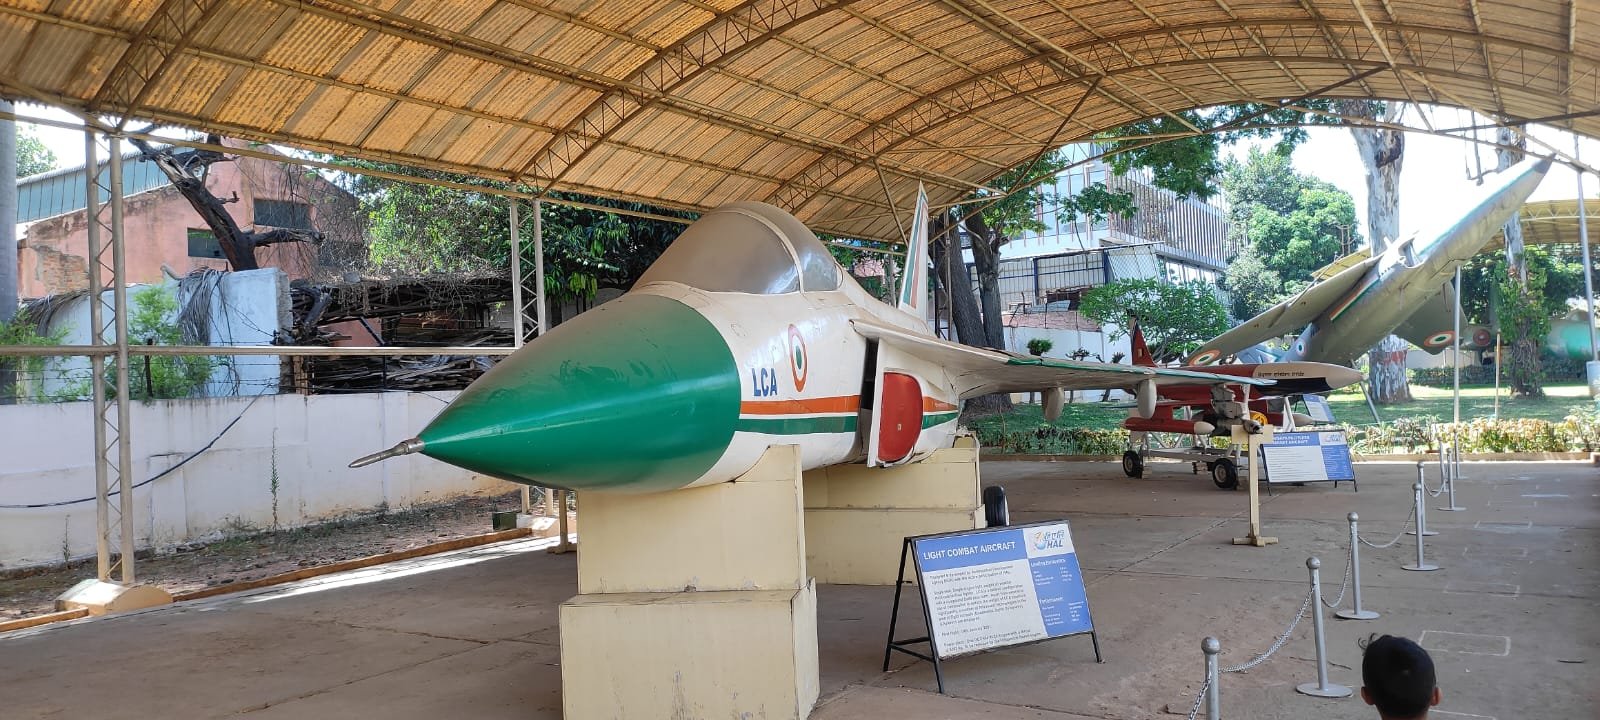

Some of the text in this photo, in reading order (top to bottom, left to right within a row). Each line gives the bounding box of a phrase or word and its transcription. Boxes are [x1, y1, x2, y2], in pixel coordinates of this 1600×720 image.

[751, 367, 778, 397] LCA
[923, 541, 1016, 560] LIGHT COMBAT AIRCRAFT
[1046, 539, 1064, 549] HAL
